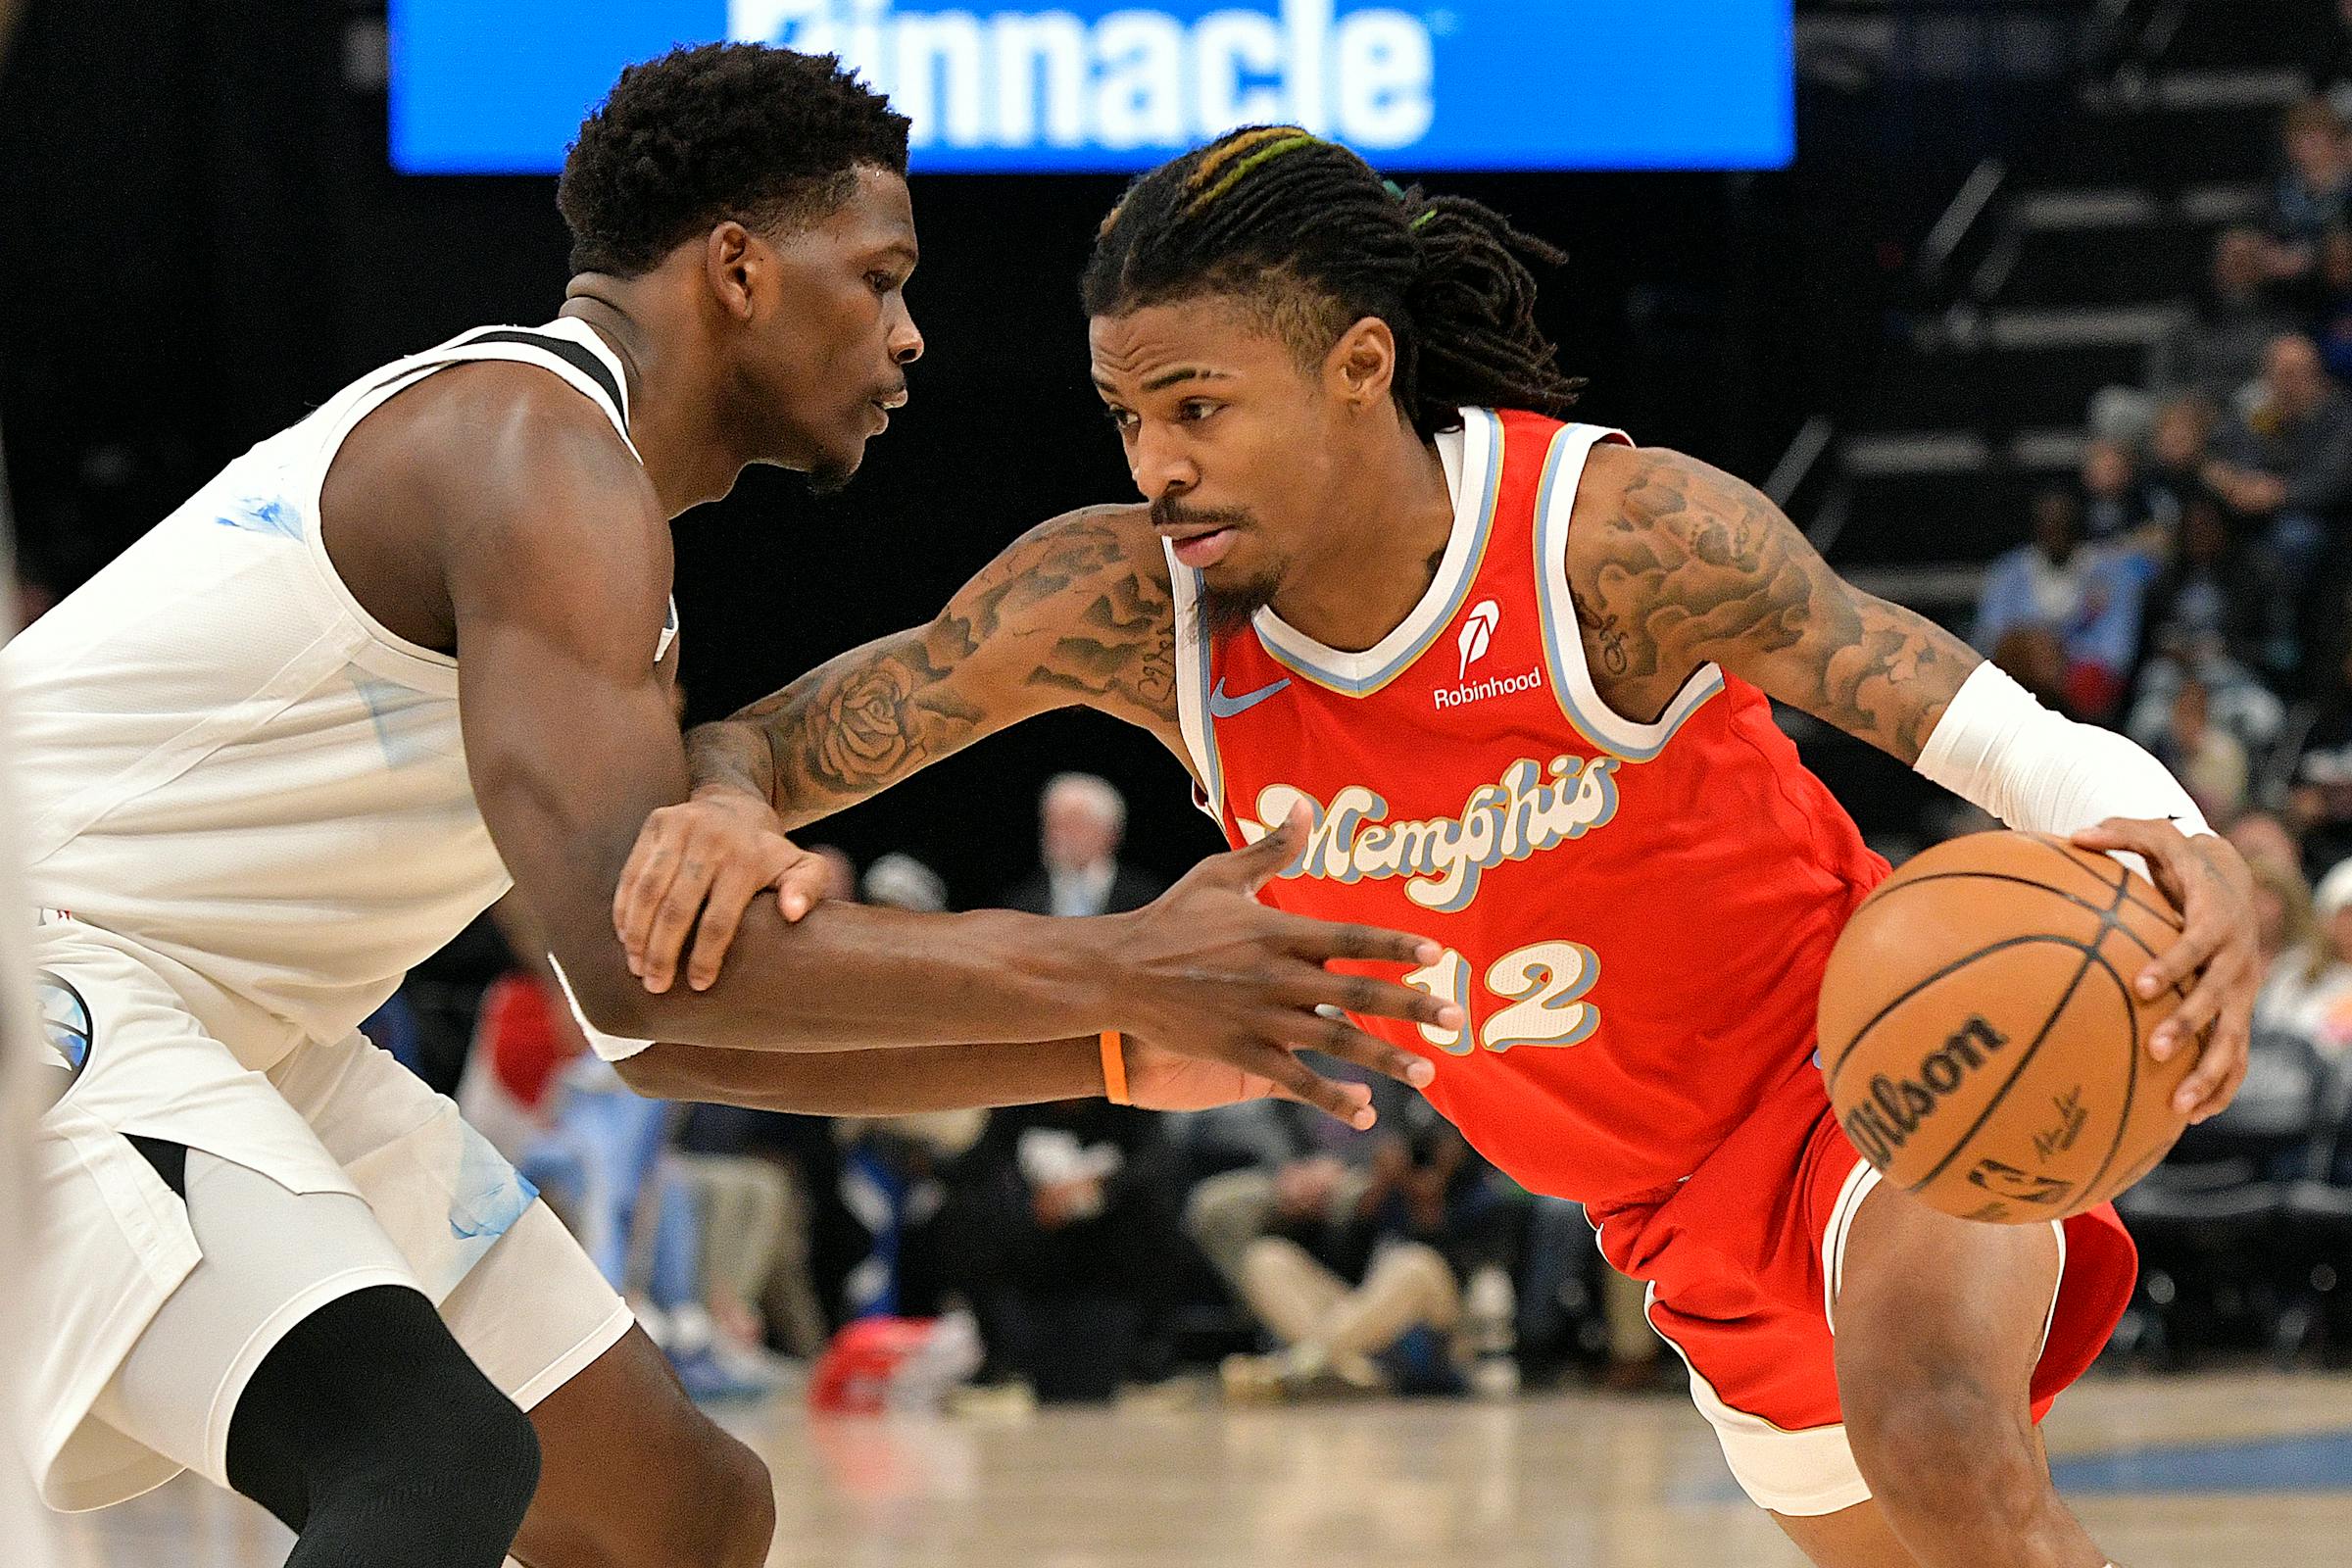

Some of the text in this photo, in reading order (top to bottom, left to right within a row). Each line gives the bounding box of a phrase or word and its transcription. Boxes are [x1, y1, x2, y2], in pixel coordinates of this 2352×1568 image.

[726, 0, 1436, 149] innacle
[1433, 666, 1543, 710] Robinhood
[1238, 756, 1620, 913] Memphis
[1401, 940, 1601, 1056] 12
